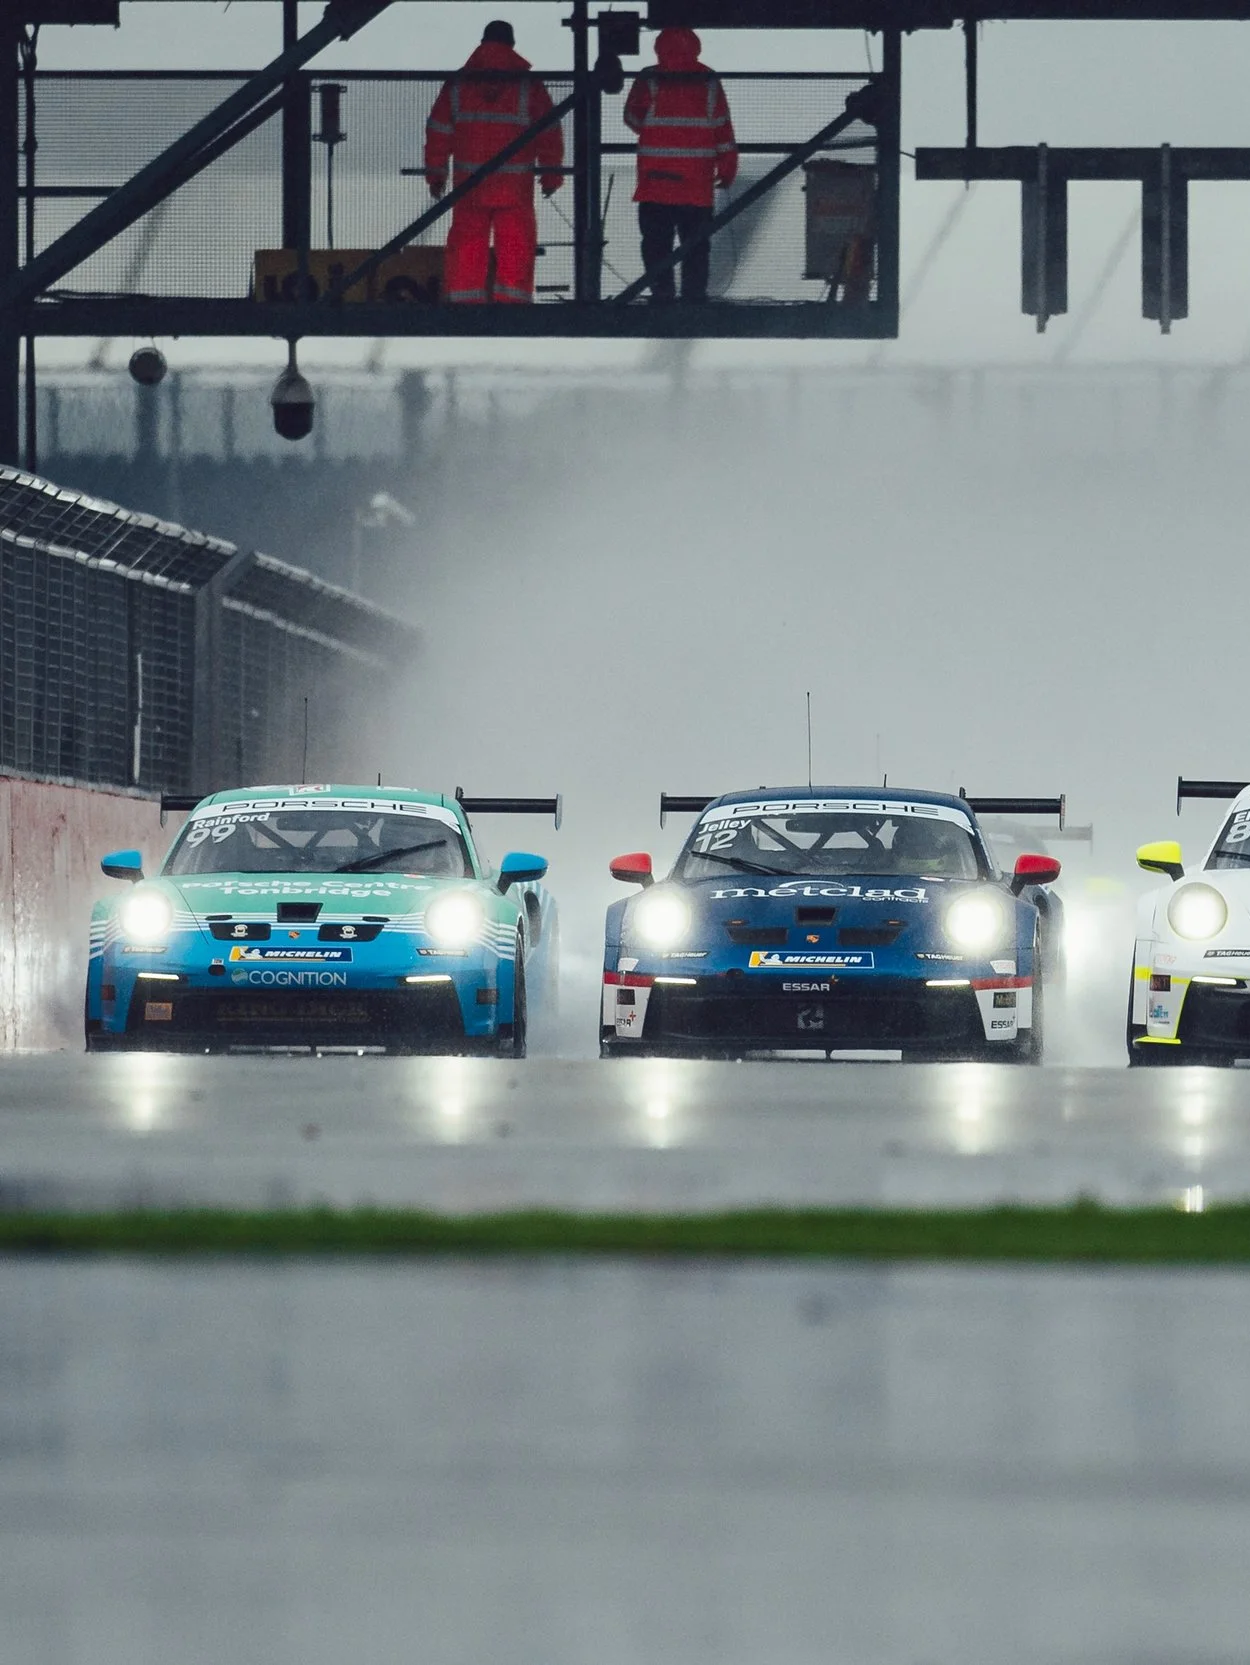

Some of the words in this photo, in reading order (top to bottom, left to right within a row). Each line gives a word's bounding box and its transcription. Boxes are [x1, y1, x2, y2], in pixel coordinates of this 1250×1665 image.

[222, 801, 427, 814] PORSCHE
[733, 802, 940, 816] PORSCHE
[192, 812, 271, 831] Rainford
[698, 819, 751, 834] Jelley
[186, 824, 236, 848] 99
[695, 829, 738, 853] 12
[219, 886, 392, 898] Tonbridge
[322, 881, 433, 890] Centre
[709, 885, 928, 899] metclad
[264, 950, 342, 958] MICHELIN
[784, 955, 863, 963] MICHELIN
[248, 970, 347, 985] COGNITION
[782, 982, 831, 992] ESSAR
